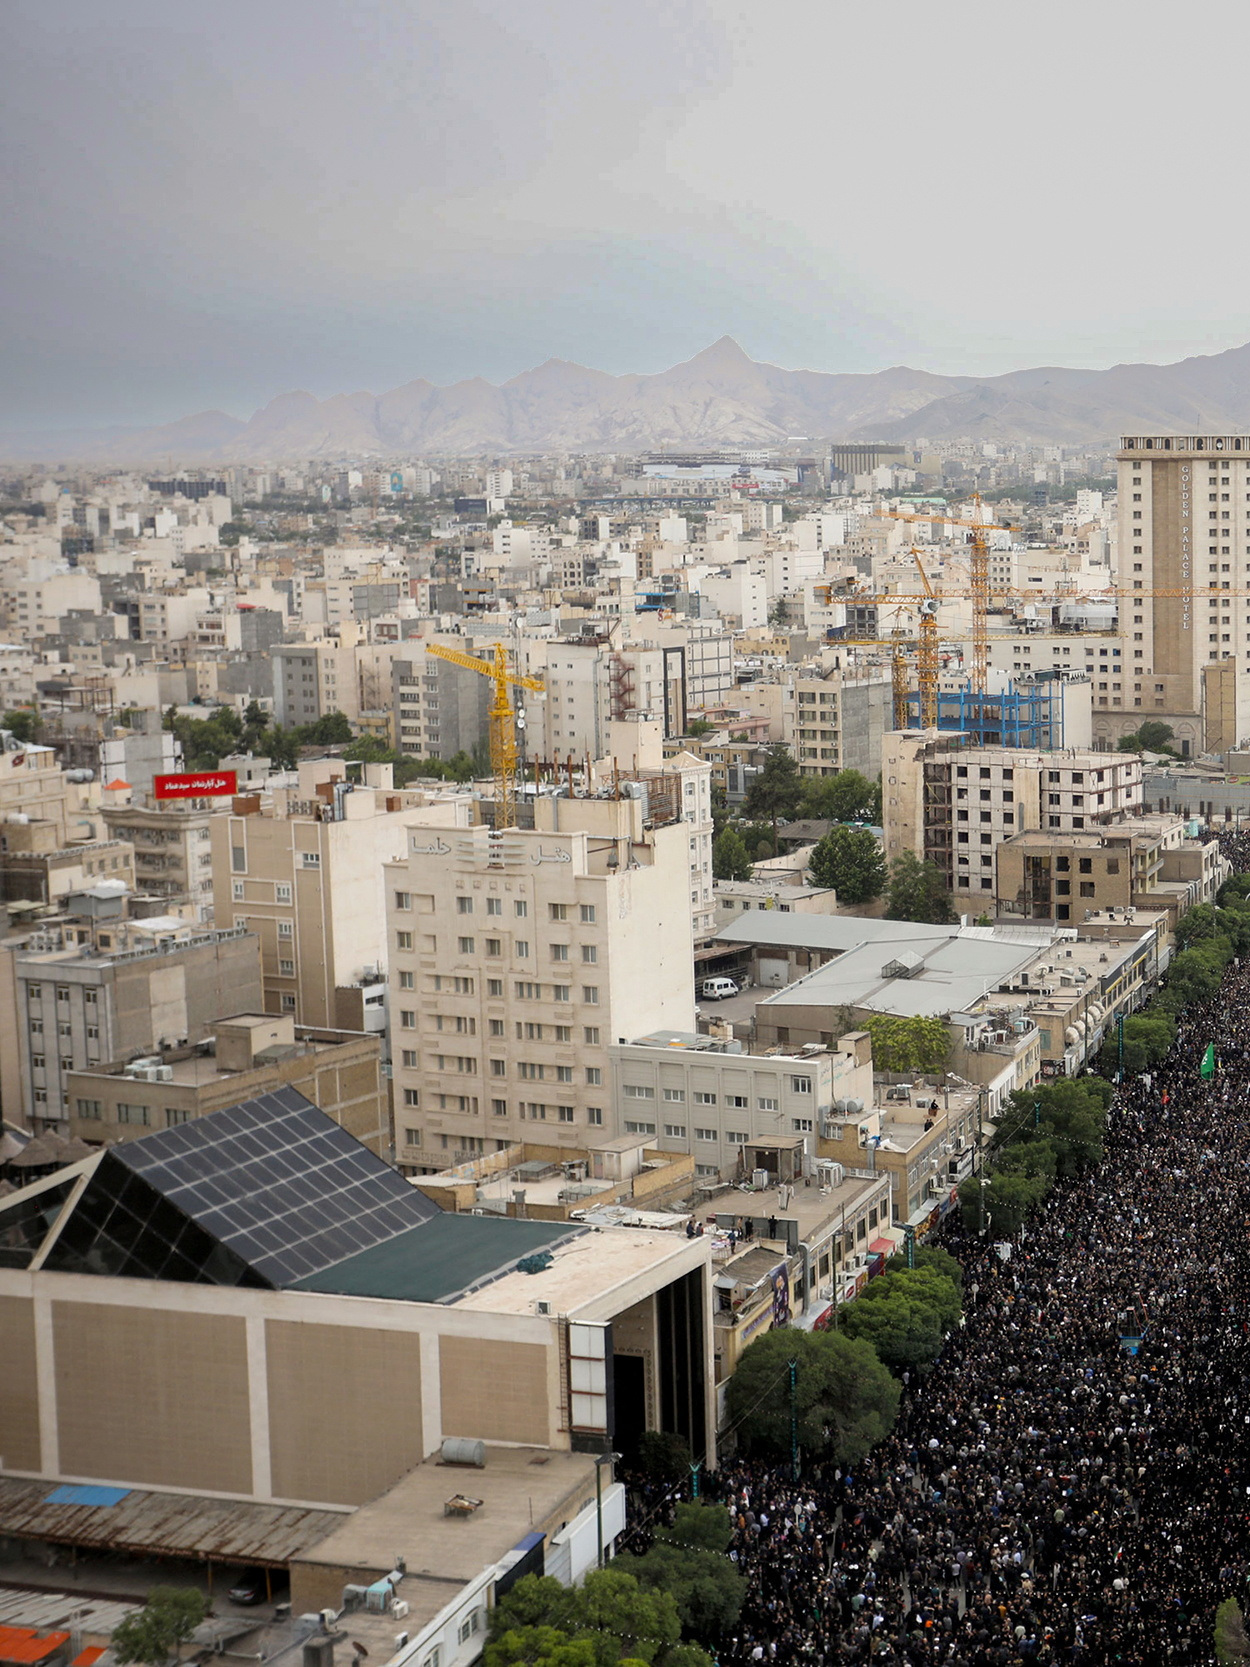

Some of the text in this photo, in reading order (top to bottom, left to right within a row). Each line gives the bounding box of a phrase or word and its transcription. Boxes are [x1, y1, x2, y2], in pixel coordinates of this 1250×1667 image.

[1181, 465, 1190, 629] GOLDEN PALACE HOTEL
[530, 845, 572, 866] هتل
